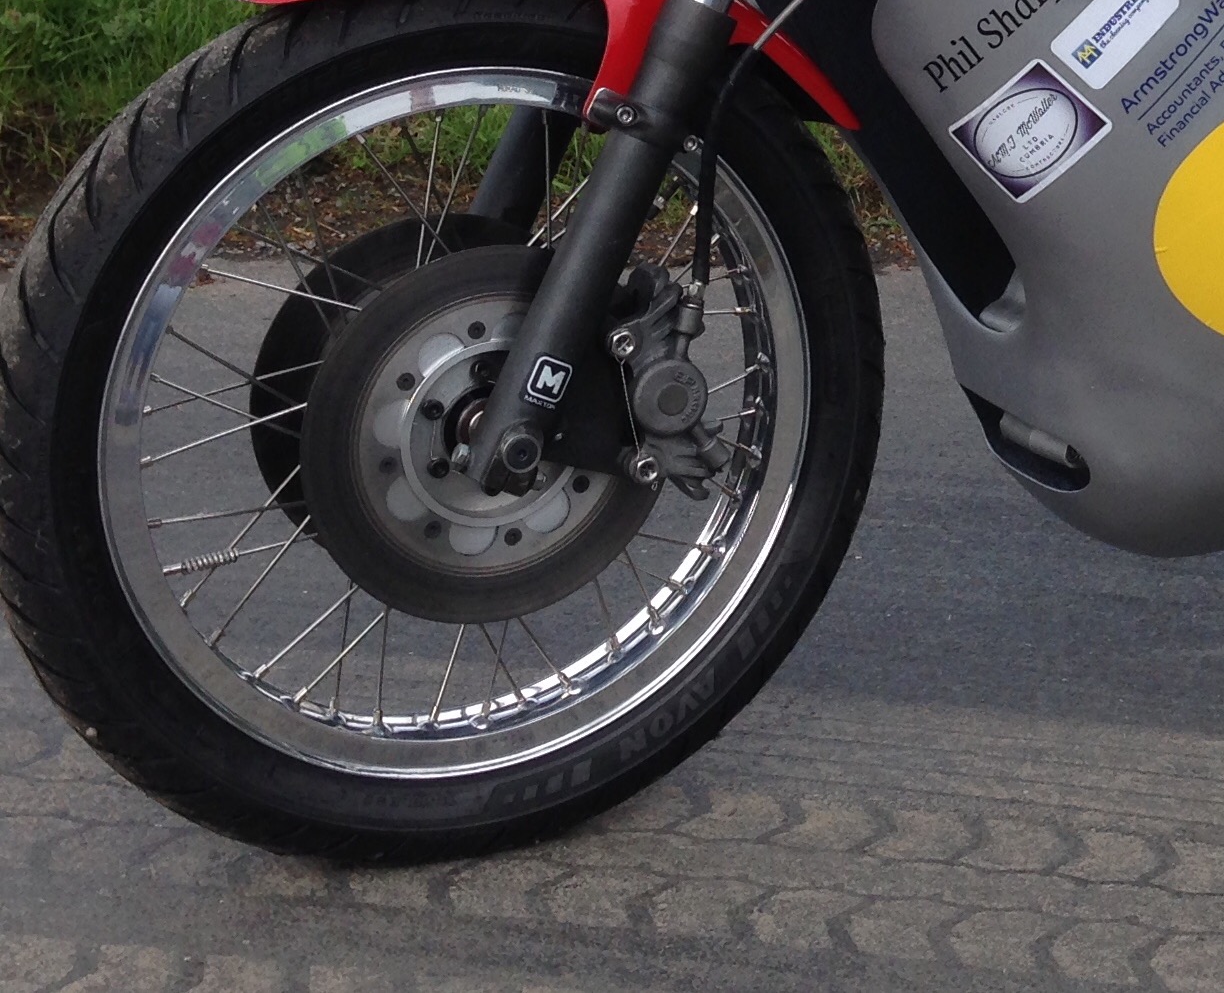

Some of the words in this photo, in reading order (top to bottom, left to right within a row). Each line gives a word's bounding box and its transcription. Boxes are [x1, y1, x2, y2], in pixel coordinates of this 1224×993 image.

[923, 35, 984, 93] Phil
[1147, 56, 1224, 135] Accountants,
[1157, 90, 1211, 148] Financial
[1019, 134, 1054, 163] CUMBRIA
[1022, 136, 1038, 150] LTD
[536, 365, 566, 395] M
[618, 666, 716, 762] AVON
